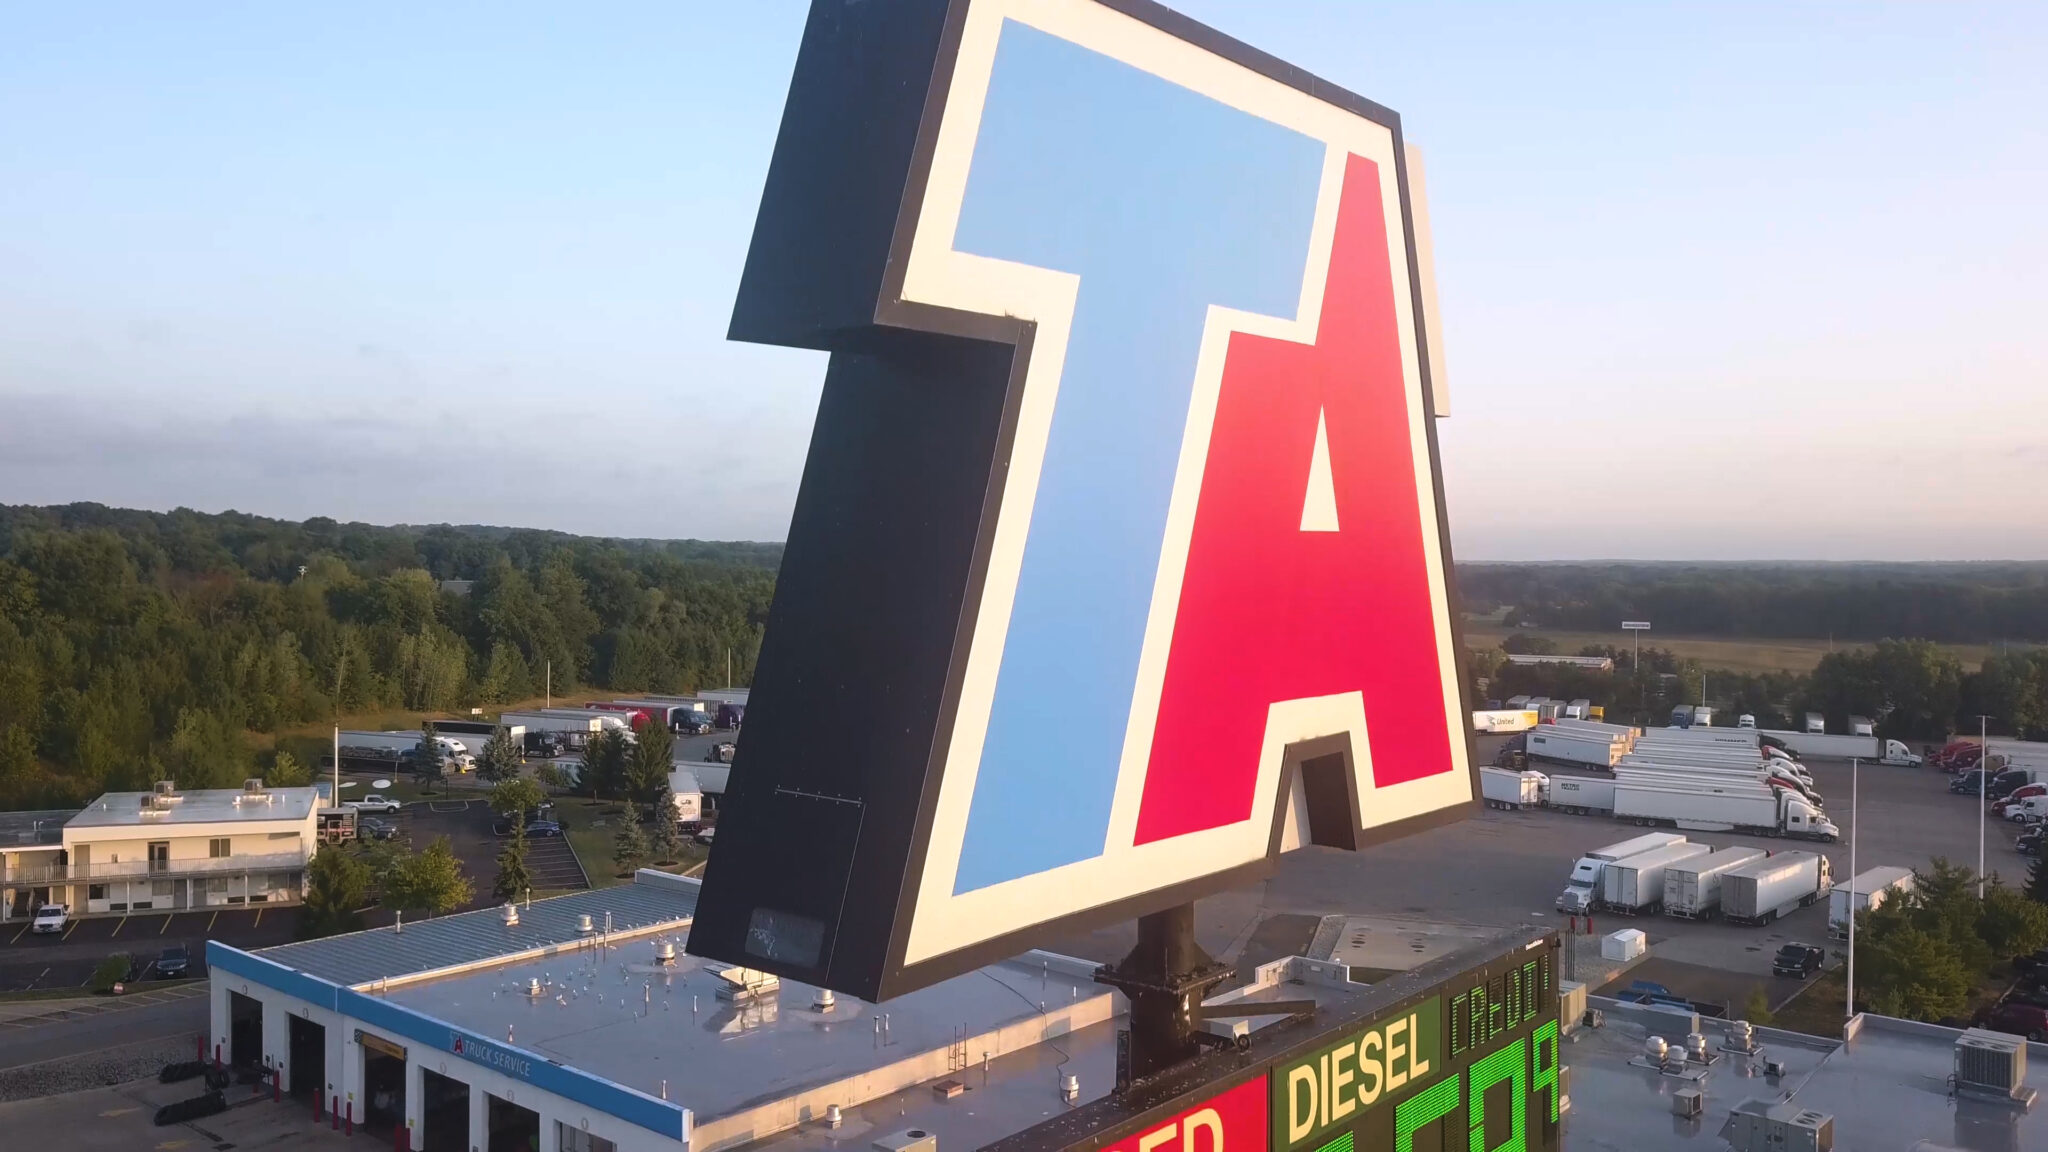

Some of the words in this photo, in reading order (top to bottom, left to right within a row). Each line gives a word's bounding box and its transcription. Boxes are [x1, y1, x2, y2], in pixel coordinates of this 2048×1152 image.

[903, 0, 1473, 966] TA
[448, 1030, 465, 1057] TA
[465, 1040, 492, 1063] TRUCK
[493, 1052, 530, 1077] SERVICE
[1289, 1014, 1430, 1144] DIESEL
